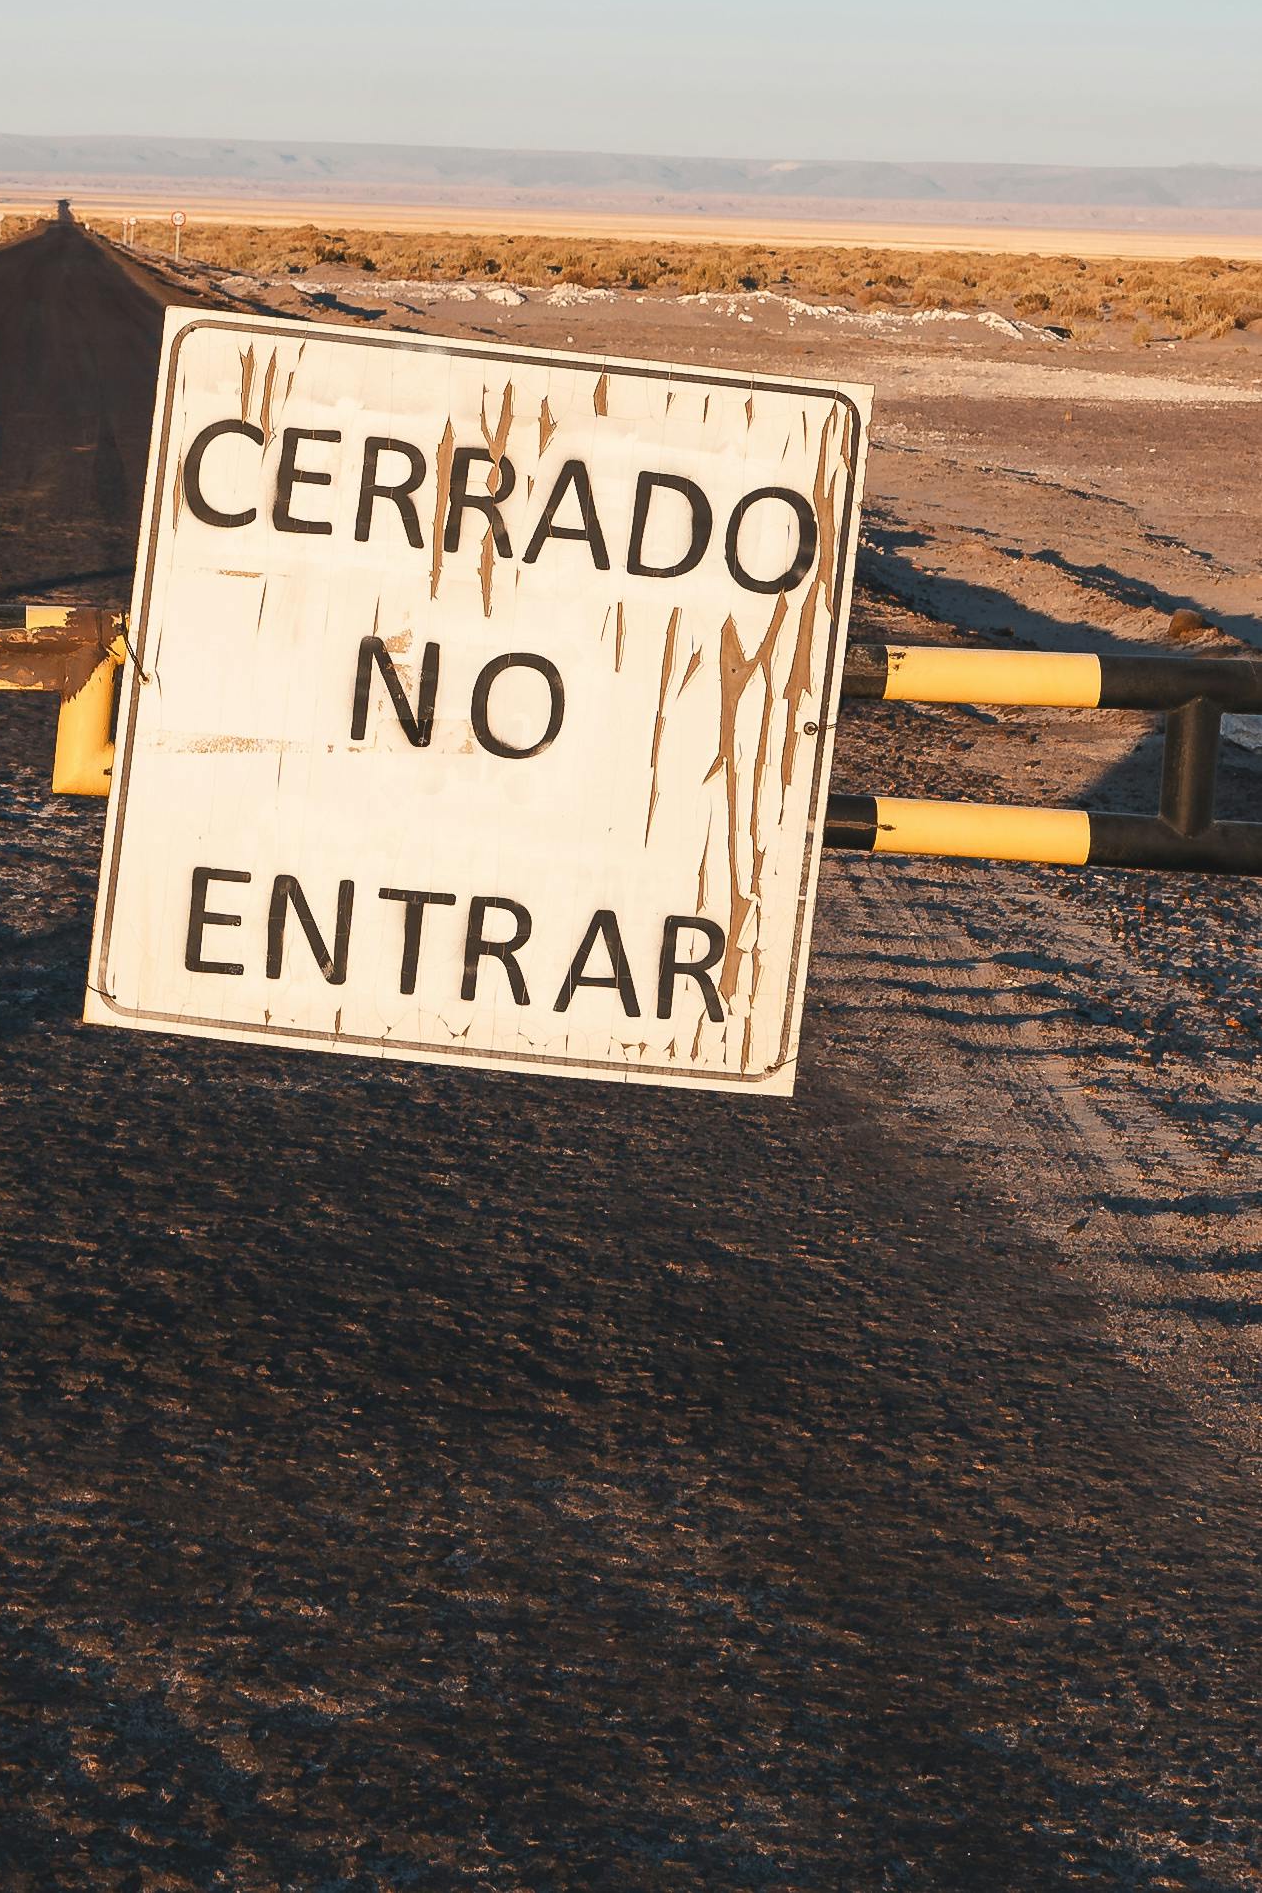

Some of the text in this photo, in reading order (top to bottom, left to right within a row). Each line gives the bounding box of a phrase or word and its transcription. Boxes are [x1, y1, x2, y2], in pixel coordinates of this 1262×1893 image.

[183, 419, 818, 595] CERRADO
[350, 636, 565, 760] NO
[184, 866, 726, 1023] ENTRAR
